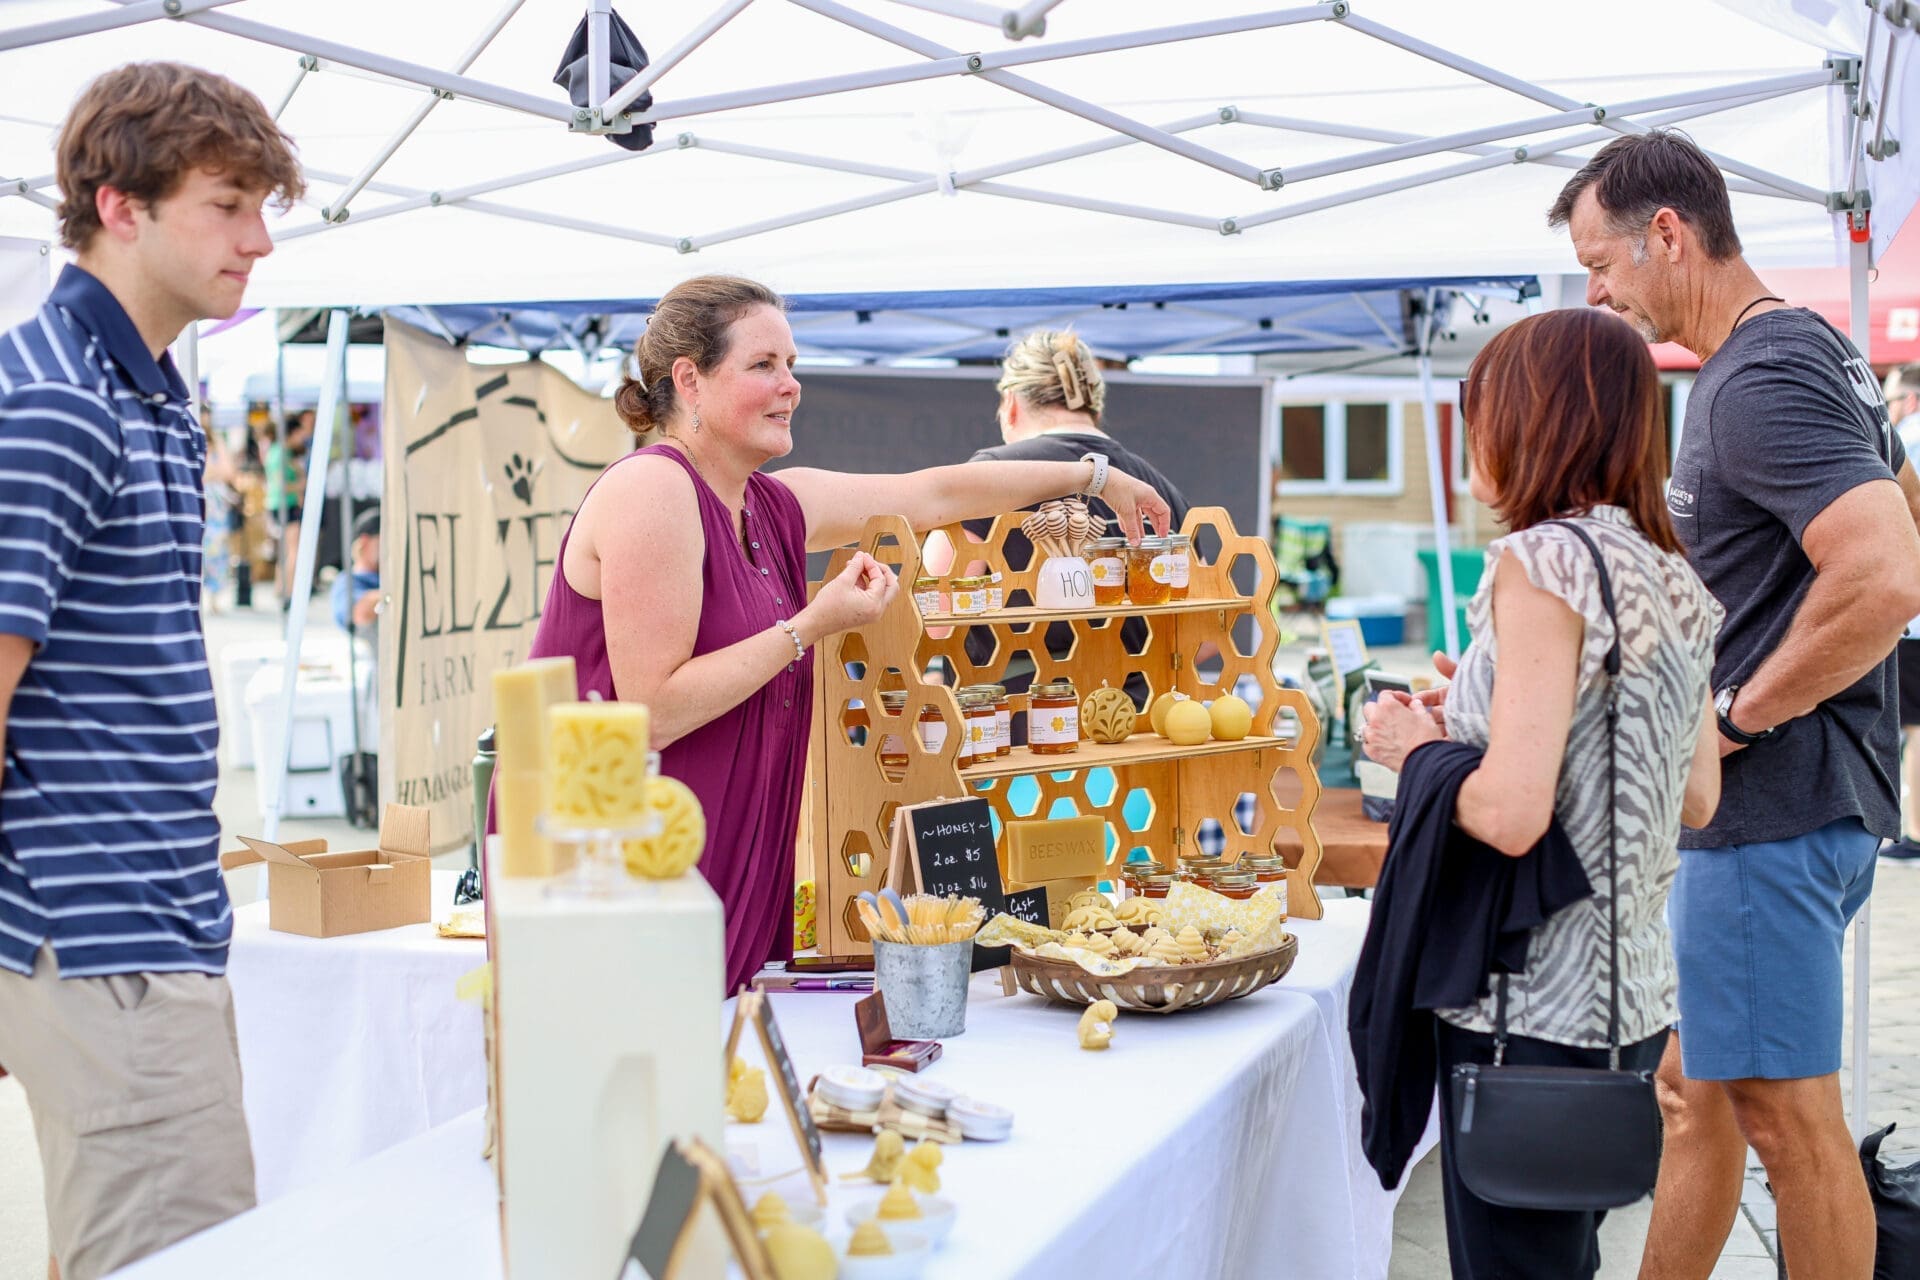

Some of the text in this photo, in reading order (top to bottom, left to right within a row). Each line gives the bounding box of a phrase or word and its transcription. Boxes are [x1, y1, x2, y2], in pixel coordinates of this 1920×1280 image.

[933, 852, 942, 866] 2
[965, 847, 981, 861] $5
[1030, 839, 1096, 859] BEESWAX
[969, 876, 987, 889] $16
